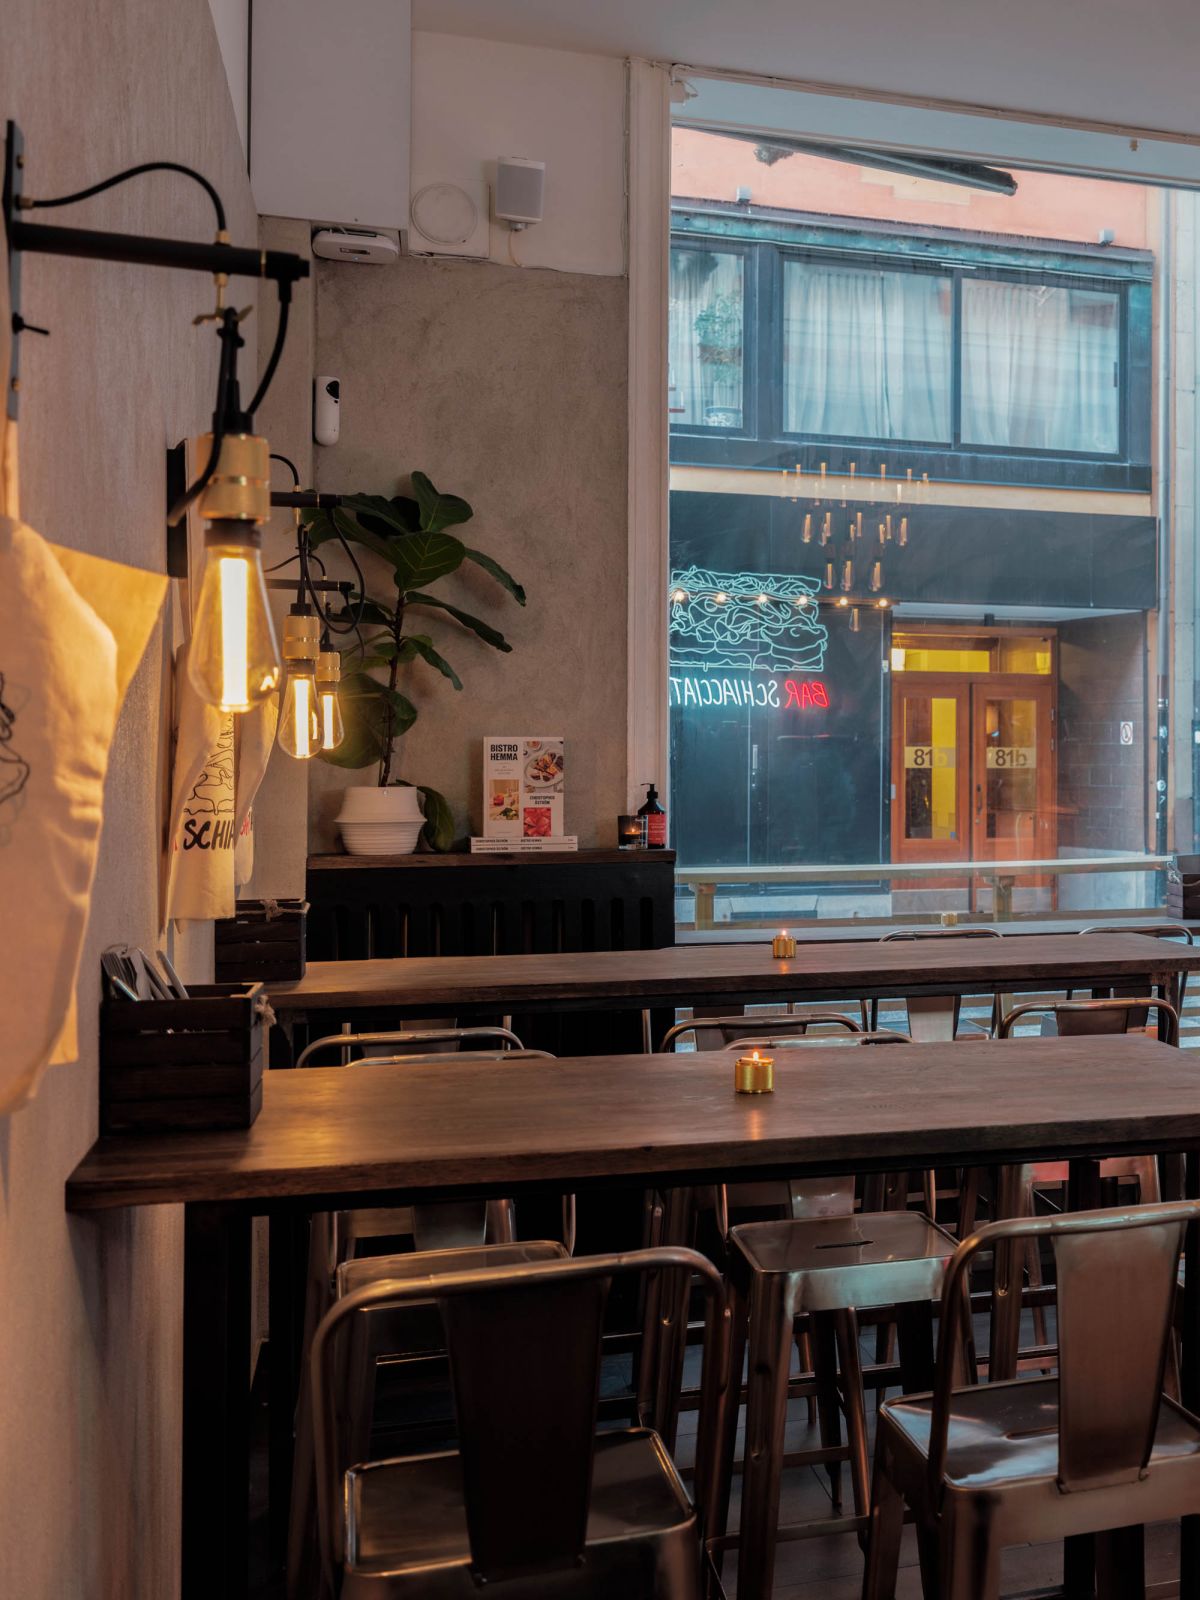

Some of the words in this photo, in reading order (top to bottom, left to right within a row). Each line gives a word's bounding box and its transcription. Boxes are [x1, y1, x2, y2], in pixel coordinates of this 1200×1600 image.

[490, 744, 518, 753] BISTRO
[490, 752, 518, 761] HEMMA
[995, 749, 1027, 767] 81b
